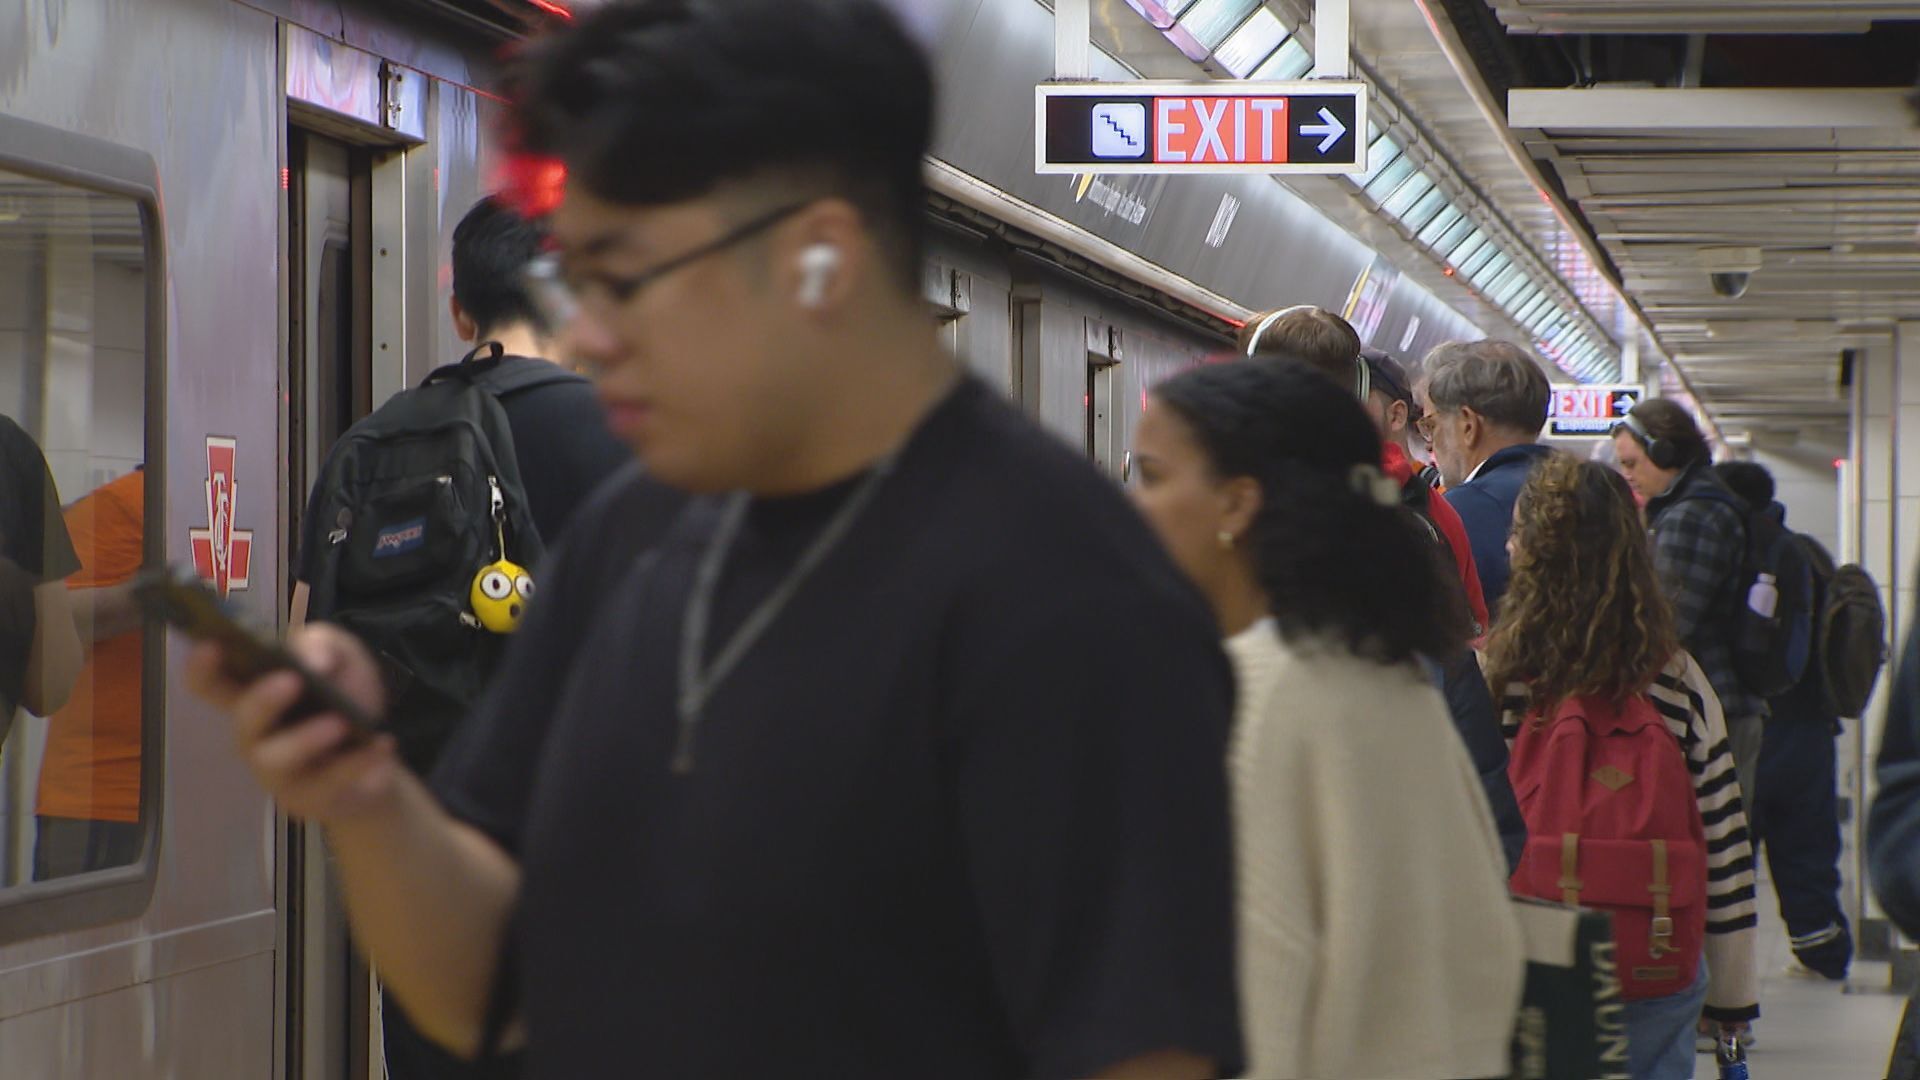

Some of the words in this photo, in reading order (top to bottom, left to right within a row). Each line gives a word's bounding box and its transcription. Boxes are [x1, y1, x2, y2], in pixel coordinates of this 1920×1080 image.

[1158, 99, 1284, 162] EXIT
[1556, 391, 1612, 416] EXIT
[1590, 942, 1632, 1080] DAUN
